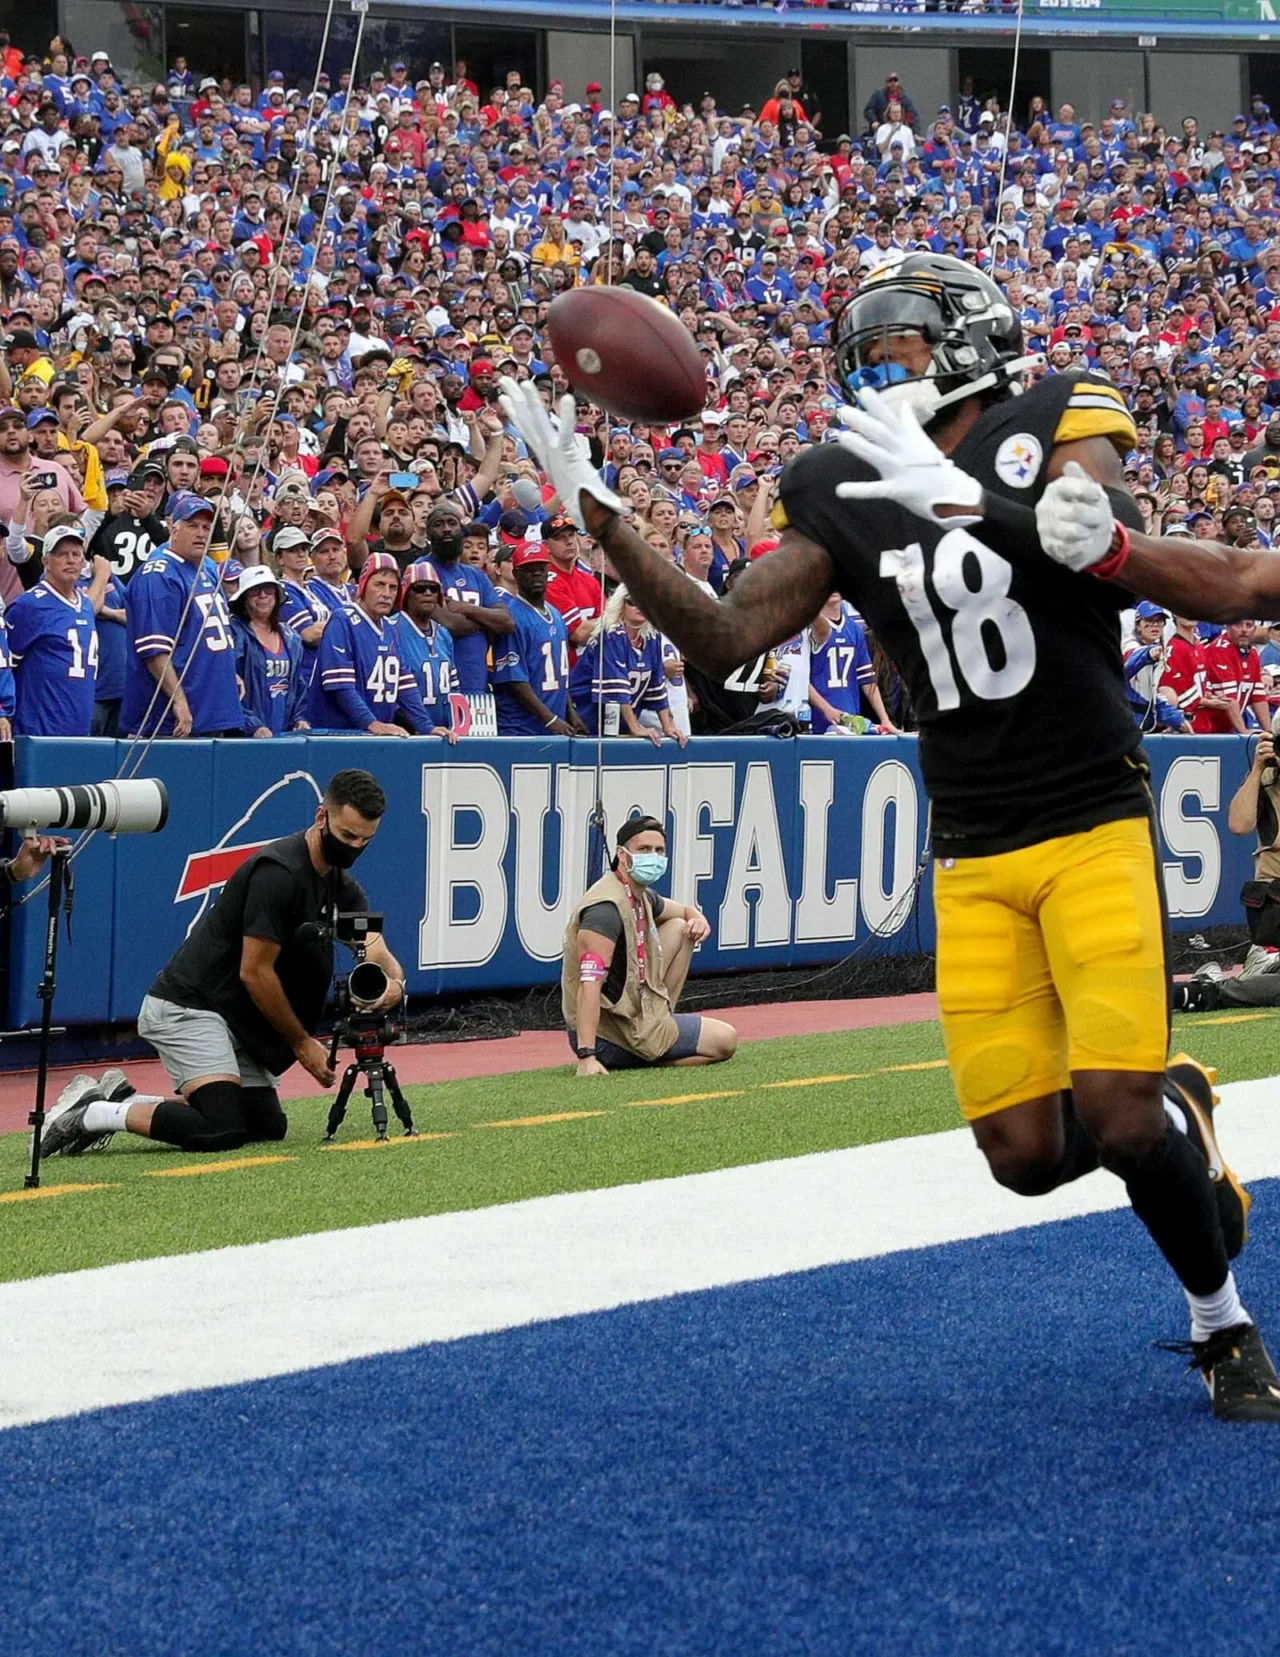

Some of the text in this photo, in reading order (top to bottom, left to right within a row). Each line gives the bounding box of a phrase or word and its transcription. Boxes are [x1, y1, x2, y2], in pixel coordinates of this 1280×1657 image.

[514, 212, 533, 229] 17
[764, 289, 782, 304] 17
[141, 559, 168, 574] 55
[193, 591, 236, 652] 55
[878, 527, 1037, 712] 18
[66, 627, 99, 680] 14
[540, 639, 570, 692] 14
[827, 646, 856, 688] 17
[366, 655, 401, 704] 49
[419, 757, 920, 972] BUFFALO
